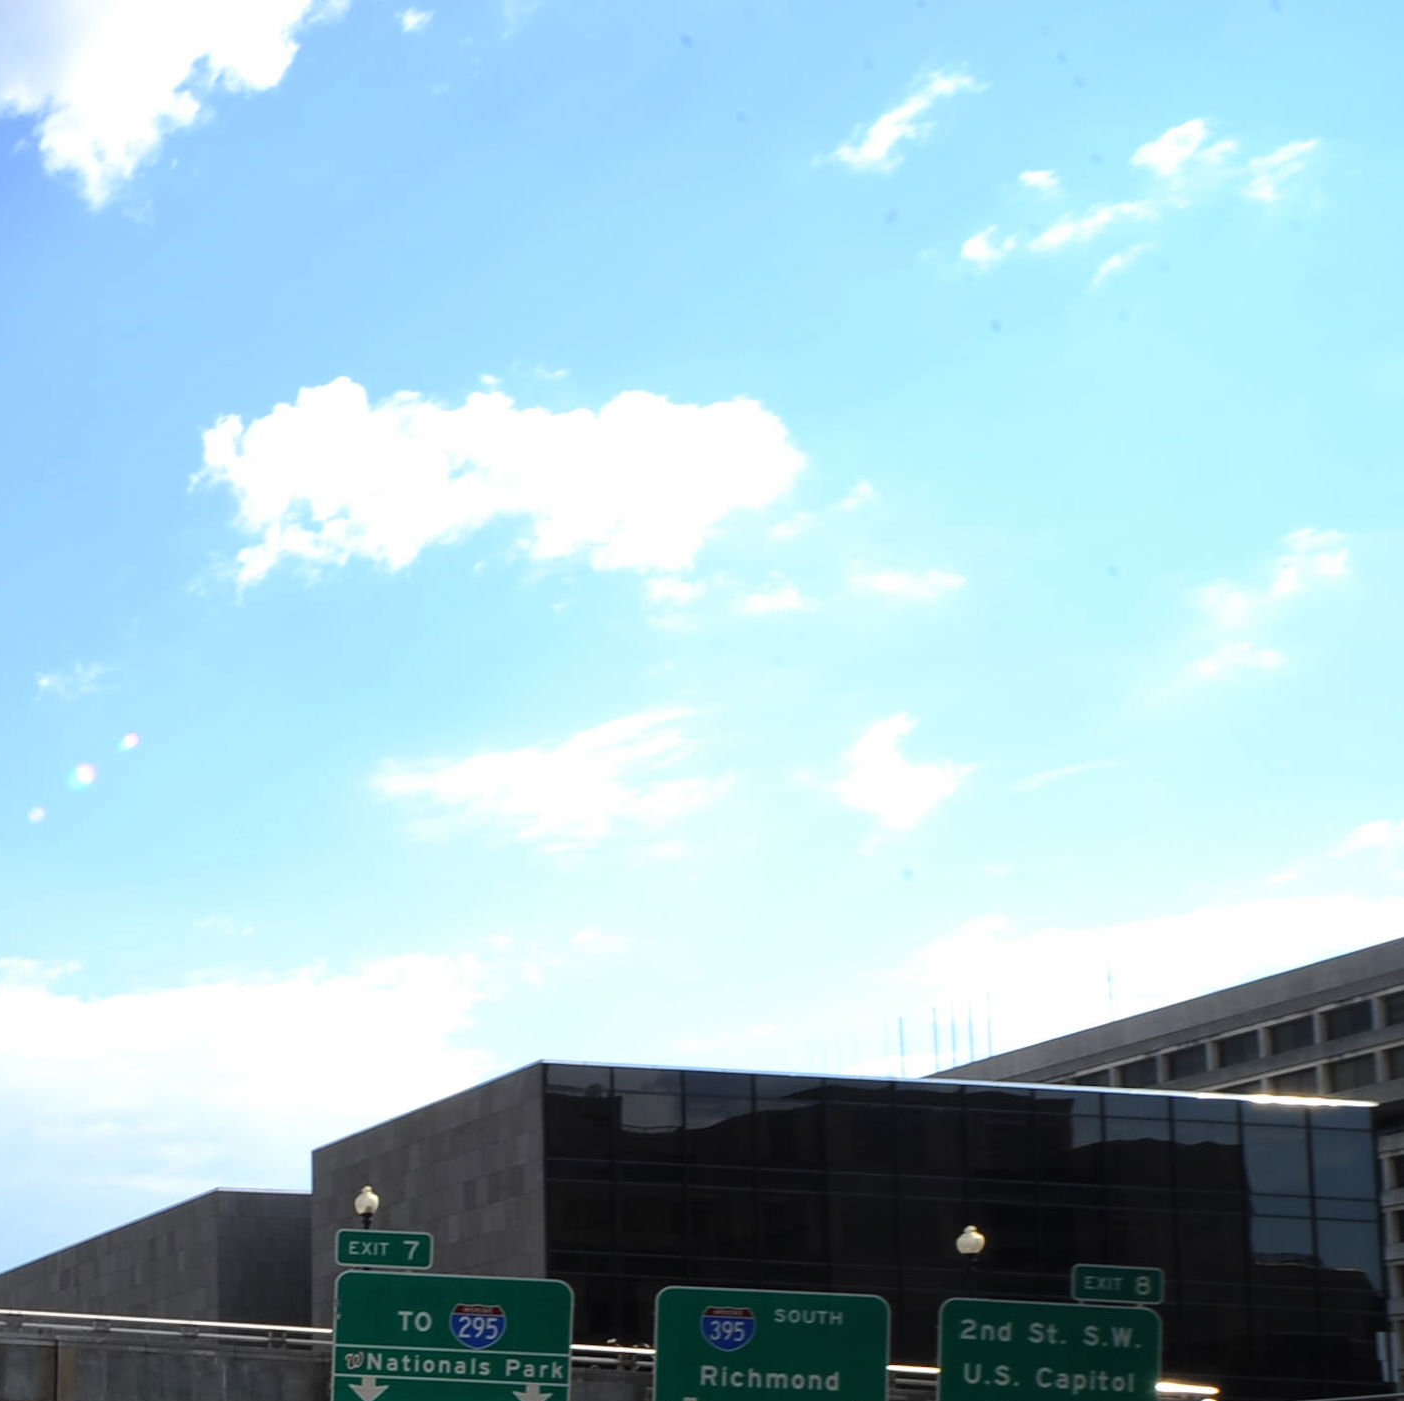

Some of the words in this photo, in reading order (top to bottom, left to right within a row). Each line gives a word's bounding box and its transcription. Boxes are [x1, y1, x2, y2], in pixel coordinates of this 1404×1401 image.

[348, 1240, 390, 1257] EXIT
[403, 1240, 420, 1260] 7
[1083, 1275, 1124, 1292] EXIT
[1135, 1275, 1152, 1296] 8
[397, 1310, 433, 1333] TO
[457, 1315, 499, 1341] 295
[709, 1320, 746, 1342] 395
[773, 1308, 844, 1326] SOUTH
[959, 1318, 1013, 1342] 2nd
[1028, 1322, 1068, 1345] St.
[1082, 1325, 1143, 1349] S.W.
[366, 1352, 491, 1376] Nationals
[505, 1358, 565, 1380] Park
[699, 1364, 841, 1392] Richmond
[963, 1363, 1021, 1387] U.S.
[1035, 1367, 1135, 1396] Capitol
